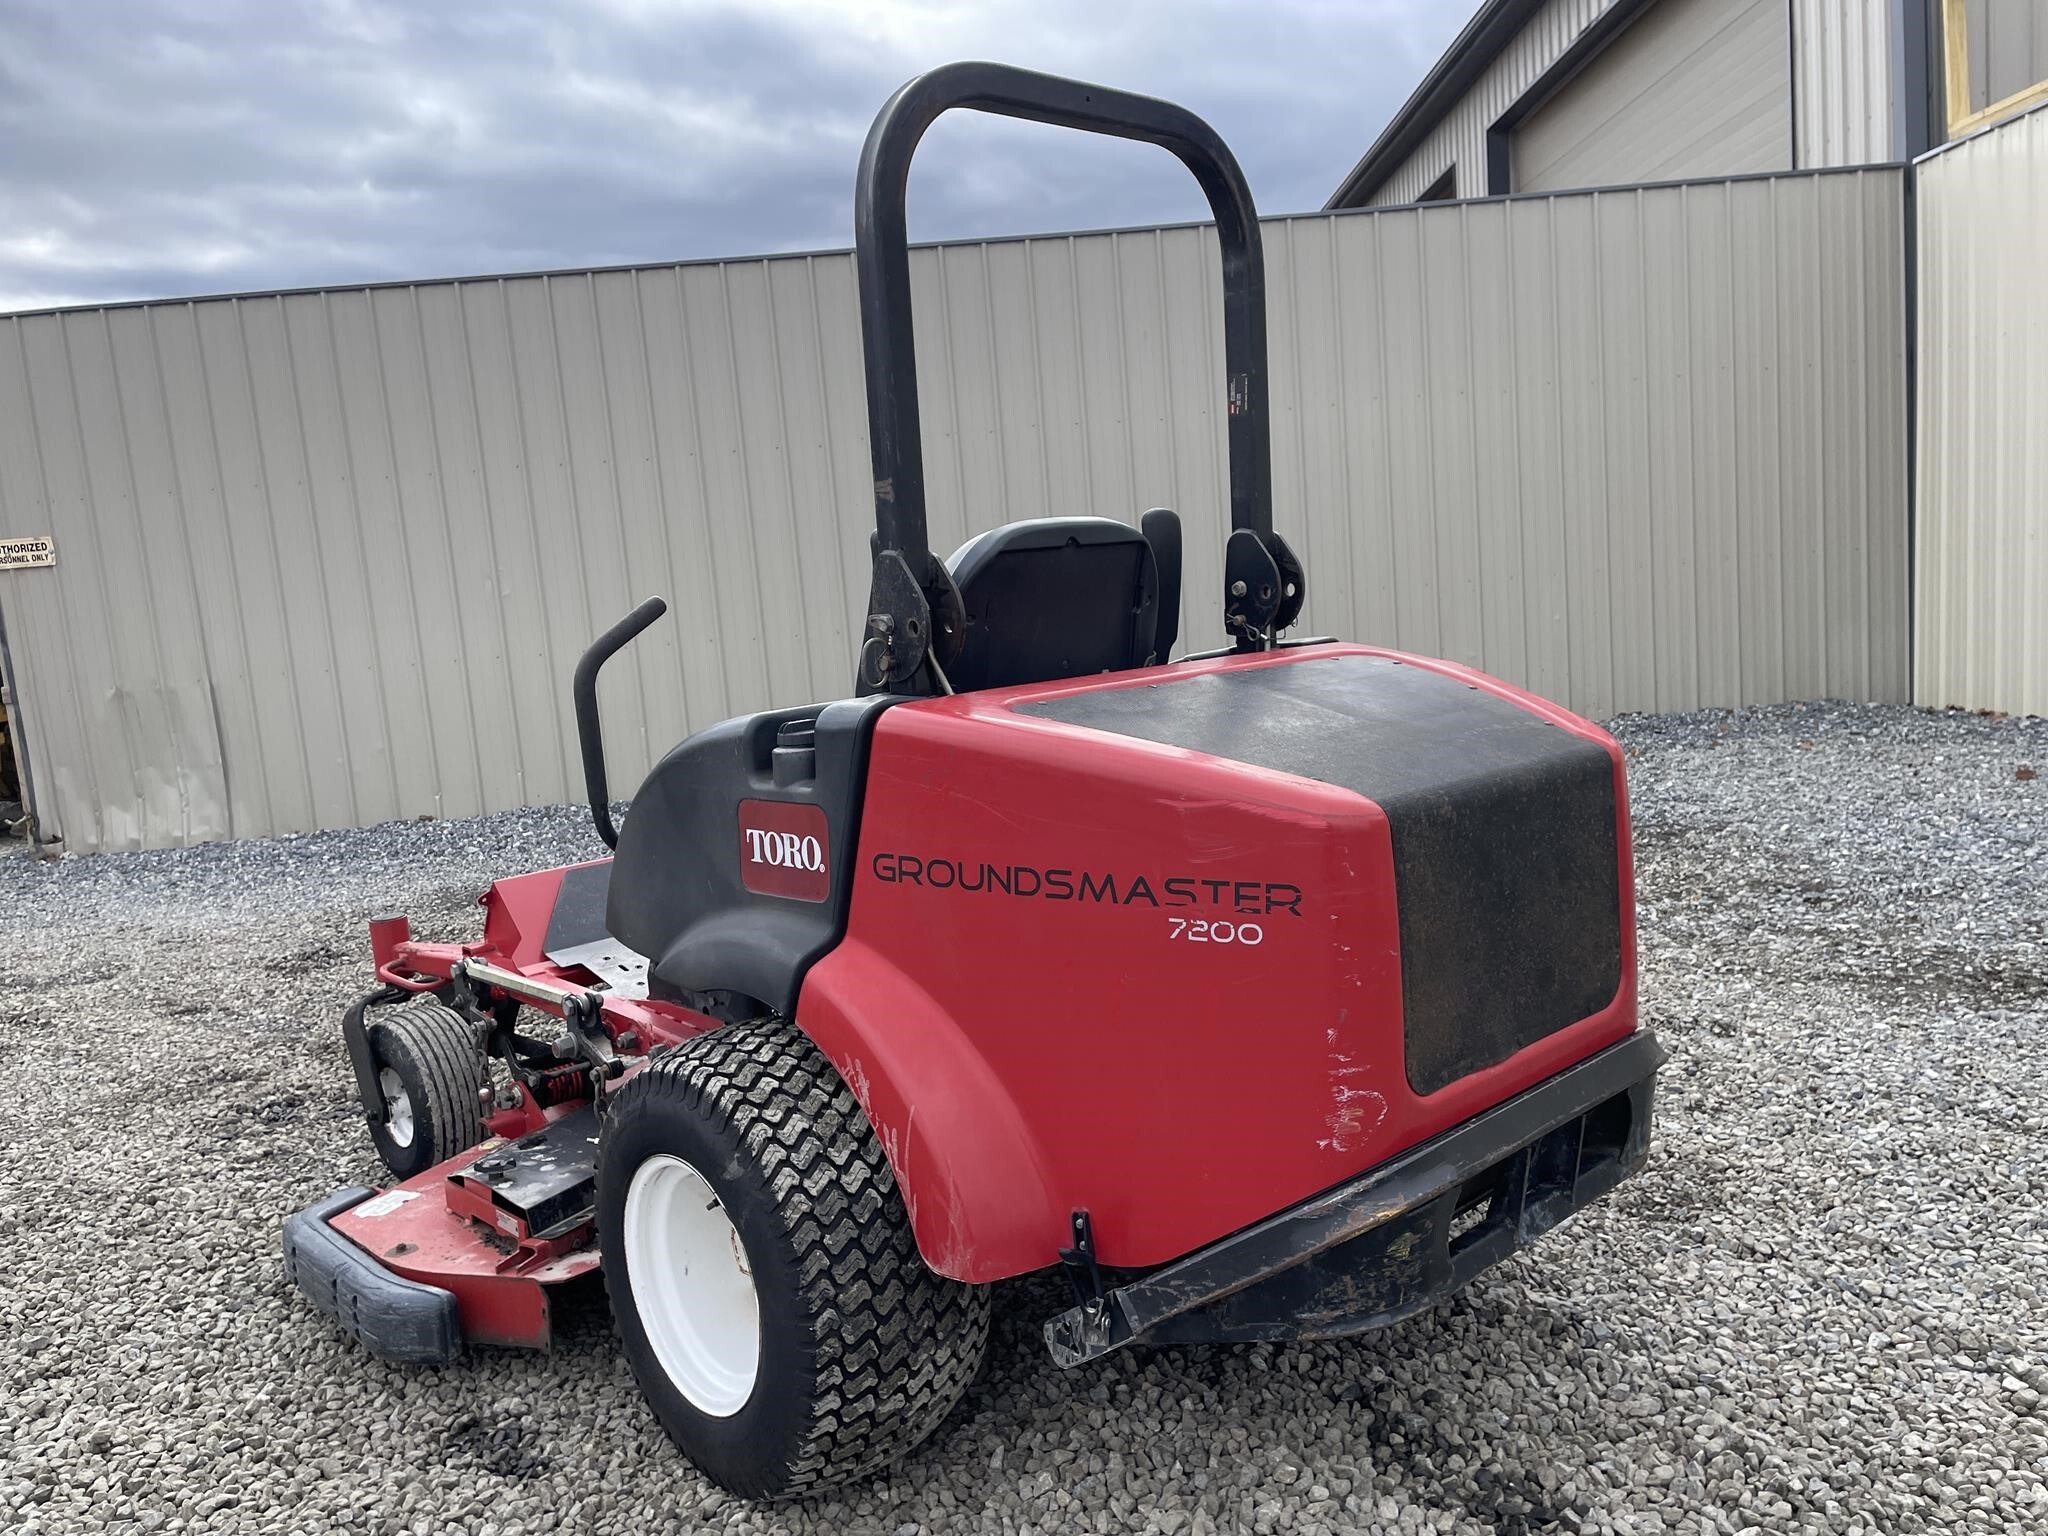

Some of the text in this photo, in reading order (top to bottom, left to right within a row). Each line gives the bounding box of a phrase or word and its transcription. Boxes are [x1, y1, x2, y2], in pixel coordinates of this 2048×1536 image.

[0, 542, 48, 554] THORIZED
[31, 553, 49, 562] ONLY
[872, 852, 1303, 917] GROUNDSMASTER
[1168, 917, 1264, 946] 7200
